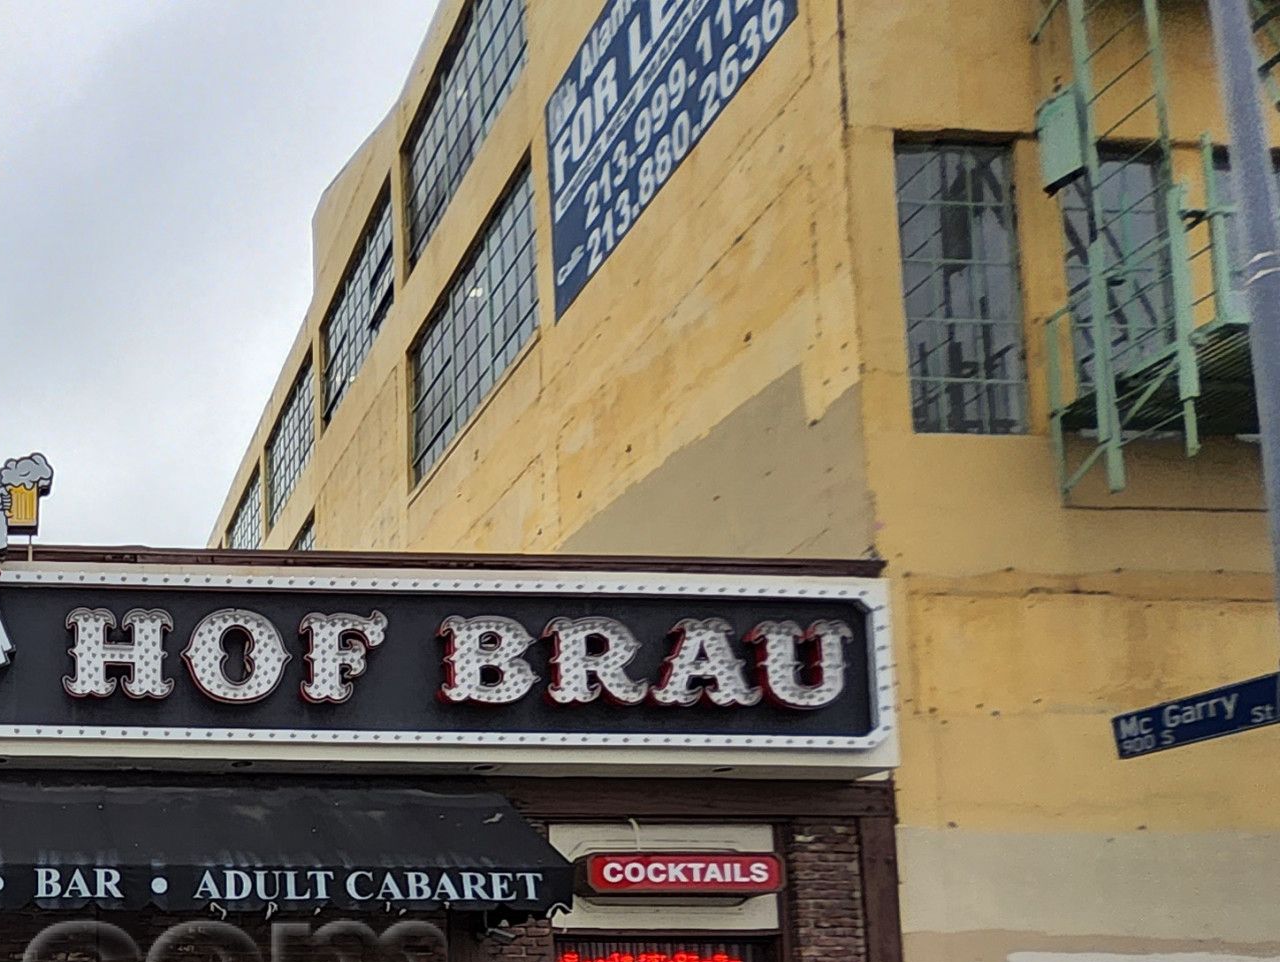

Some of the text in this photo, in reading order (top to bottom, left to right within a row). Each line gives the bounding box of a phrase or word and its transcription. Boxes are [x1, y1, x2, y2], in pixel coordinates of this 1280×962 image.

[553, 57, 618, 195] FOR
[585, 0, 754, 229] 213.999.11
[586, 0, 784, 276] 213.880.2636
[62, 606, 389, 706] HOF
[435, 614, 855, 711] BRAU
[1120, 693, 1275, 740] Mc Garry St
[35, 867, 124, 901] BAR
[194, 869, 333, 903] ADULT
[345, 870, 543, 903] CABARET
[603, 862, 769, 883] COCKTAILS
